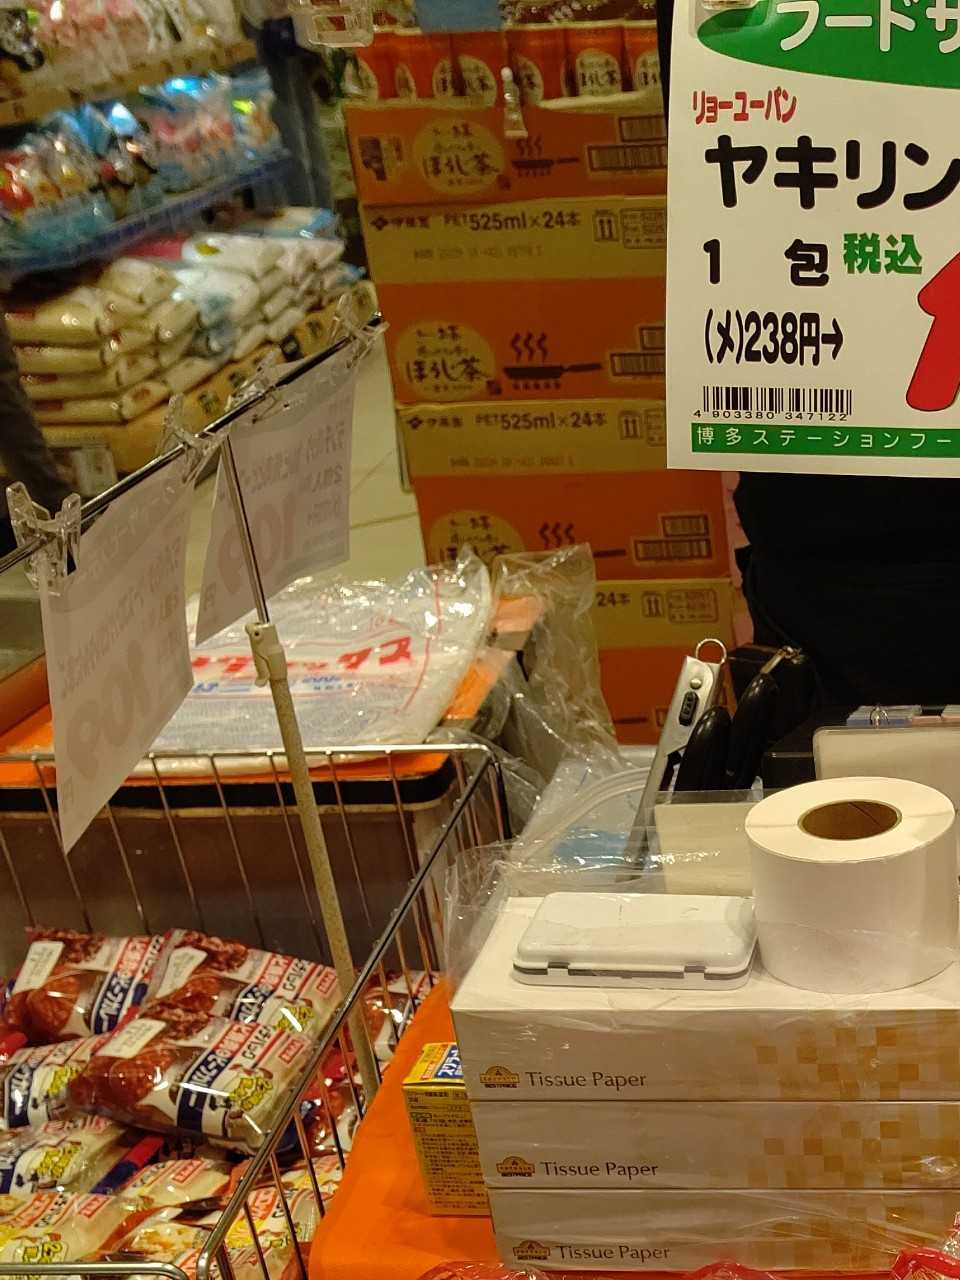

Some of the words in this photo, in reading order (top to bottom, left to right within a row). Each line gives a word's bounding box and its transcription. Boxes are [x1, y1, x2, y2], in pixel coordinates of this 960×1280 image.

[692, 86, 798, 125] リョーユーパン
[843, 232, 923, 275] 税込
[525, 1072, 586, 1087] Tissue
[592, 1072, 647, 1091] Paper
[540, 1161, 600, 1177] Tissue
[605, 1161, 659, 1181] Paper
[556, 1245, 615, 1260] Tissue
[619, 1245, 671, 1264] Paper
